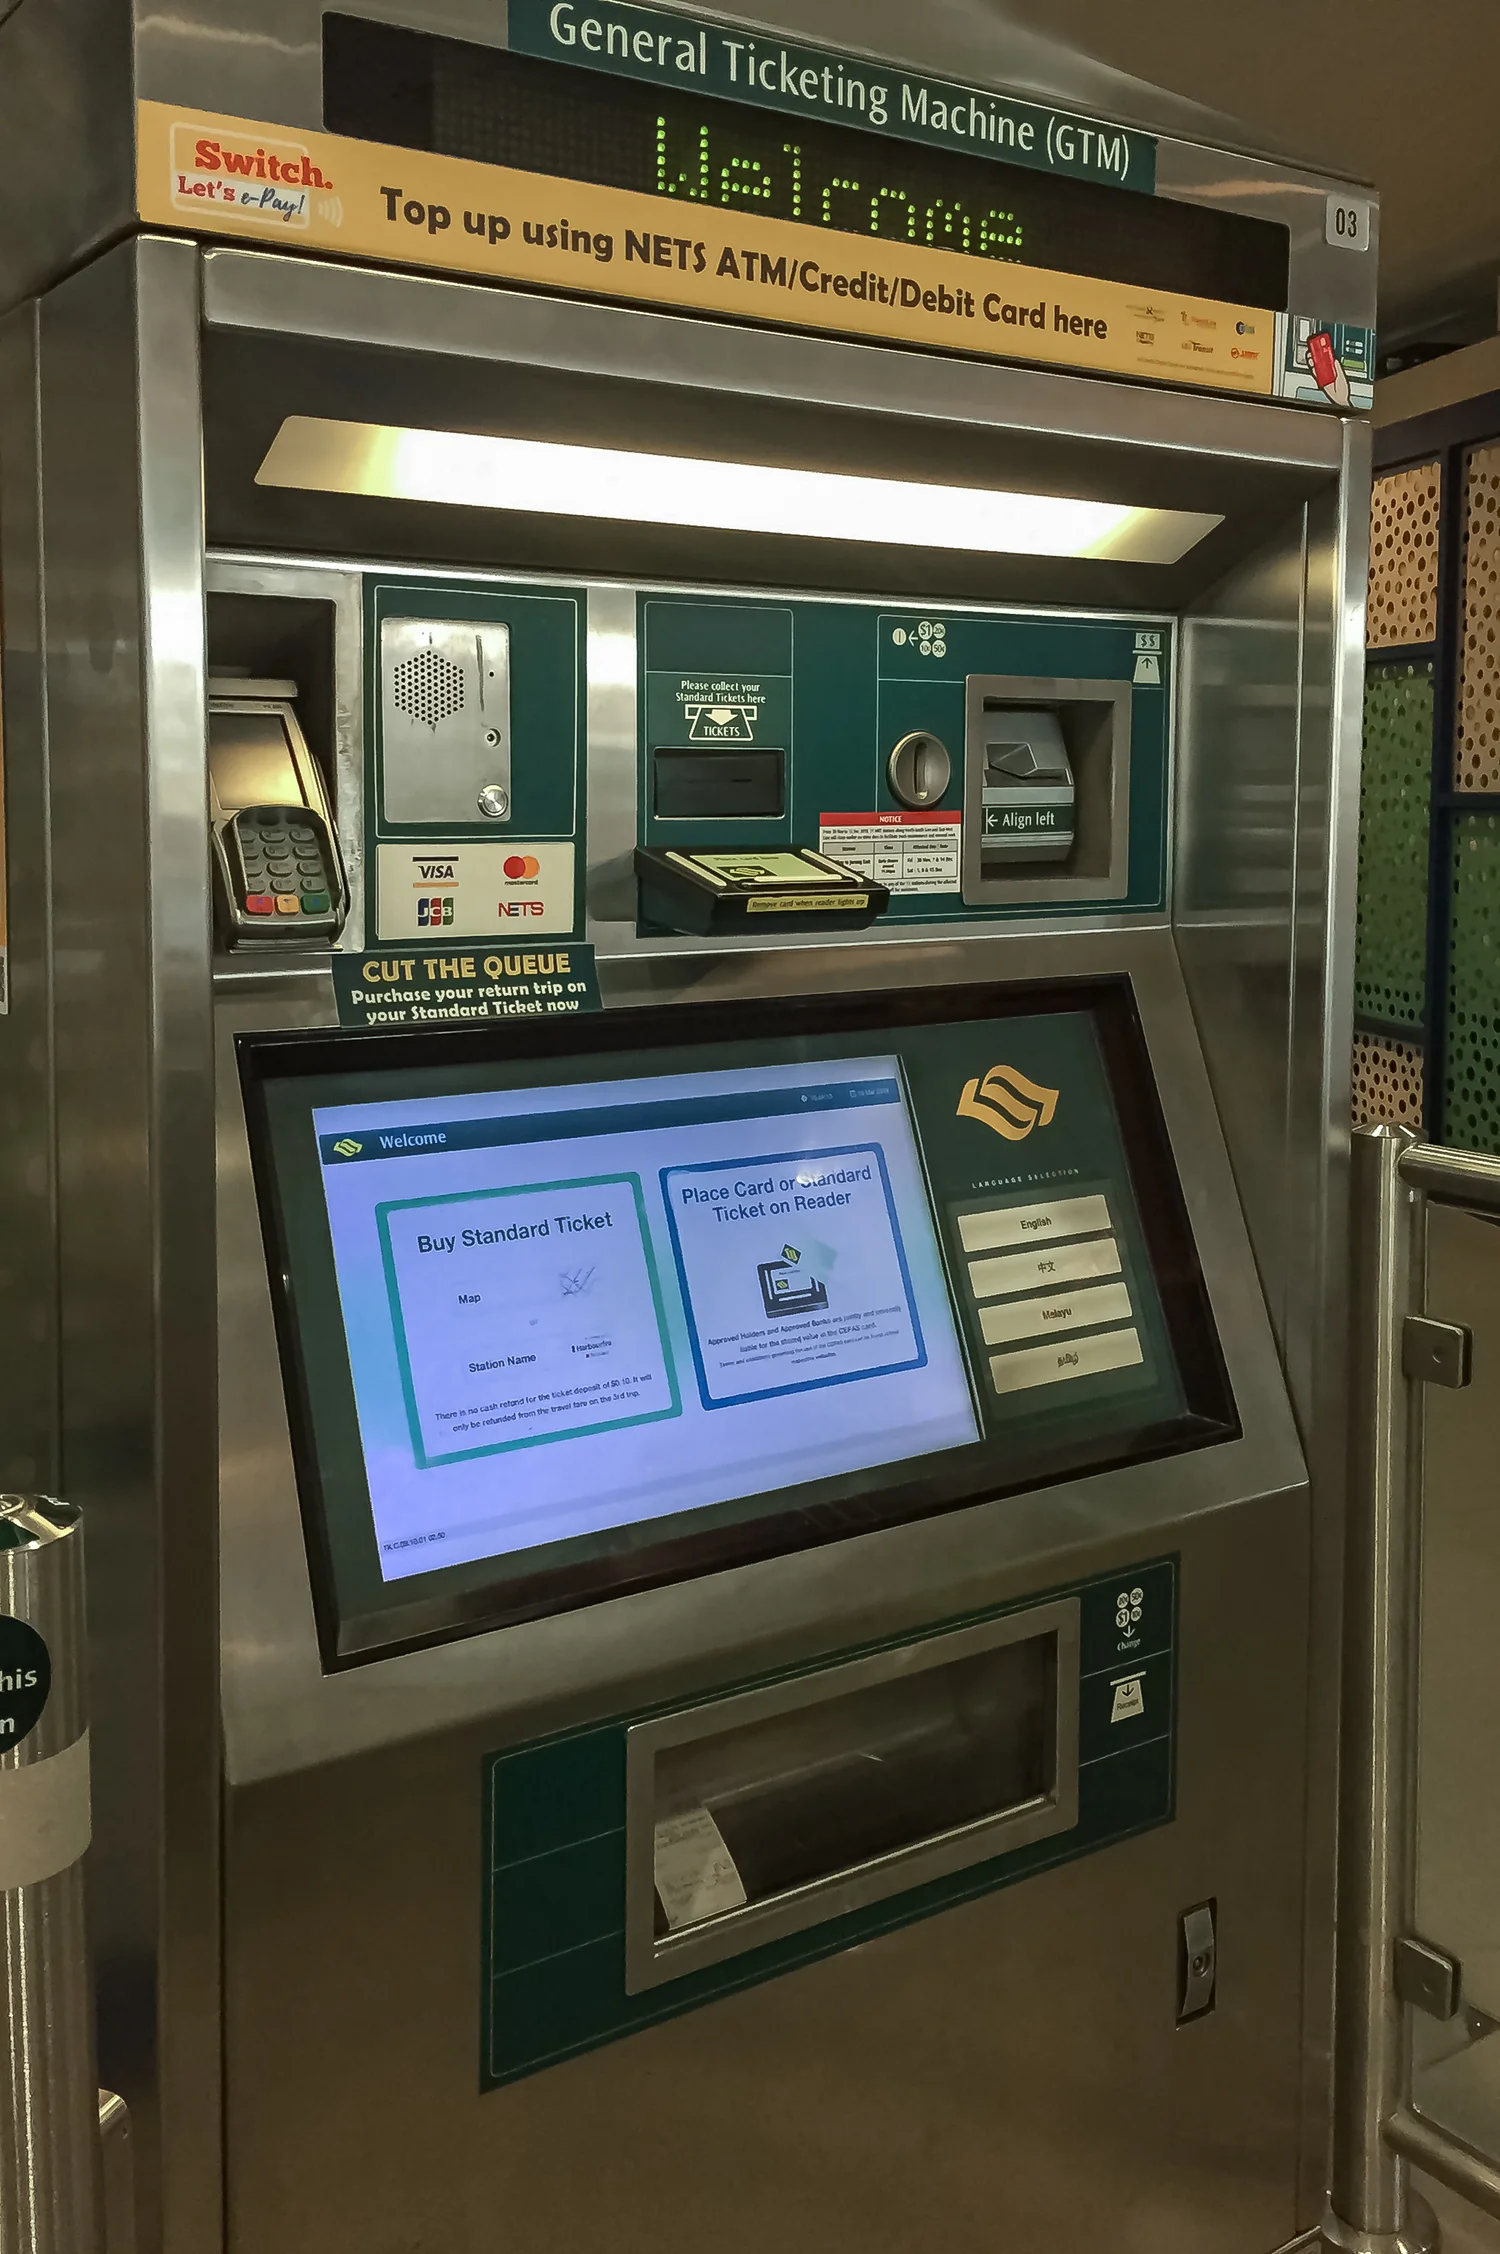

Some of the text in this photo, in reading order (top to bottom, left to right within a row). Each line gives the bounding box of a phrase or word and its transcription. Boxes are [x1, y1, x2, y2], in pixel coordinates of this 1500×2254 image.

[549, 2, 1130, 182] General Ticketing Machine (GTM)
[194, 139, 334, 190] Switch.
[177, 175, 306, 222] Let's e-Pay!
[1335, 207, 1358, 238] 03
[380, 186, 451, 236] Top
[463, 208, 511, 243] up
[523, 218, 613, 262] using
[624, 229, 708, 275] NETS
[715, 246, 975, 319] ATM/Credit/Debit
[984, 292, 1049, 331] Card
[1053, 304, 1108, 341] here
[681, 680, 761, 693] Please collect your
[675, 692, 767, 704] Standard Tickets here
[703, 726, 740, 737] TICKETS
[879, 815, 902, 823] NOTICE
[1002, 811, 1055, 829] Align left
[417, 865, 454, 879] VISA
[417, 904, 454, 919] JCB
[498, 901, 544, 917] NETS
[362, 953, 572, 983] CUT THE QUEUE
[351, 980, 587, 1004] Purchase your return trip on
[366, 999, 580, 1025] your Standard Ticket now
[379, 1131, 447, 1149] Welcome
[972, 1168, 1079, 1189] LANGUAGE SELECTION
[681, 1187, 730, 1204] Place
[734, 1178, 775, 1198] Card
[779, 1178, 796, 1192] or
[712, 1192, 852, 1222] Ticket on Reader
[417, 1211, 613, 1254] Buy Standard Ticket
[1020, 1216, 1052, 1230] English
[1037, 1261, 1056, 1274] 中文
[458, 1293, 482, 1304] Map
[1042, 1308, 1072, 1320] Melayu
[707, 1334, 740, 1346] Approved
[740, 1330, 766, 1340] Holders
[767, 1327, 780, 1335] and
[780, 1321, 811, 1333] Approved
[759, 1341, 768, 1349] for
[769, 1338, 780, 1347] the
[468, 1353, 537, 1373] Station Name
[435, 1411, 458, 1421] There
[468, 1407, 479, 1415] no
[480, 1403, 499, 1414] cash
[538, 1392, 551, 1402] the
[552, 1389, 573, 1400] ticket
[574, 1383, 601, 1396] deposit
[602, 1380, 610, 1389] of
[453, 1423, 469, 1432] only
[470, 1420, 481, 1428] be
[482, 1413, 517, 1427] refunded
[518, 1409, 536, 1420] from
[537, 1406, 549, 1416] the
[551, 1403, 572, 1414] travel
[589, 1397, 599, 1406] on
[600, 1394, 612, 1404] the
